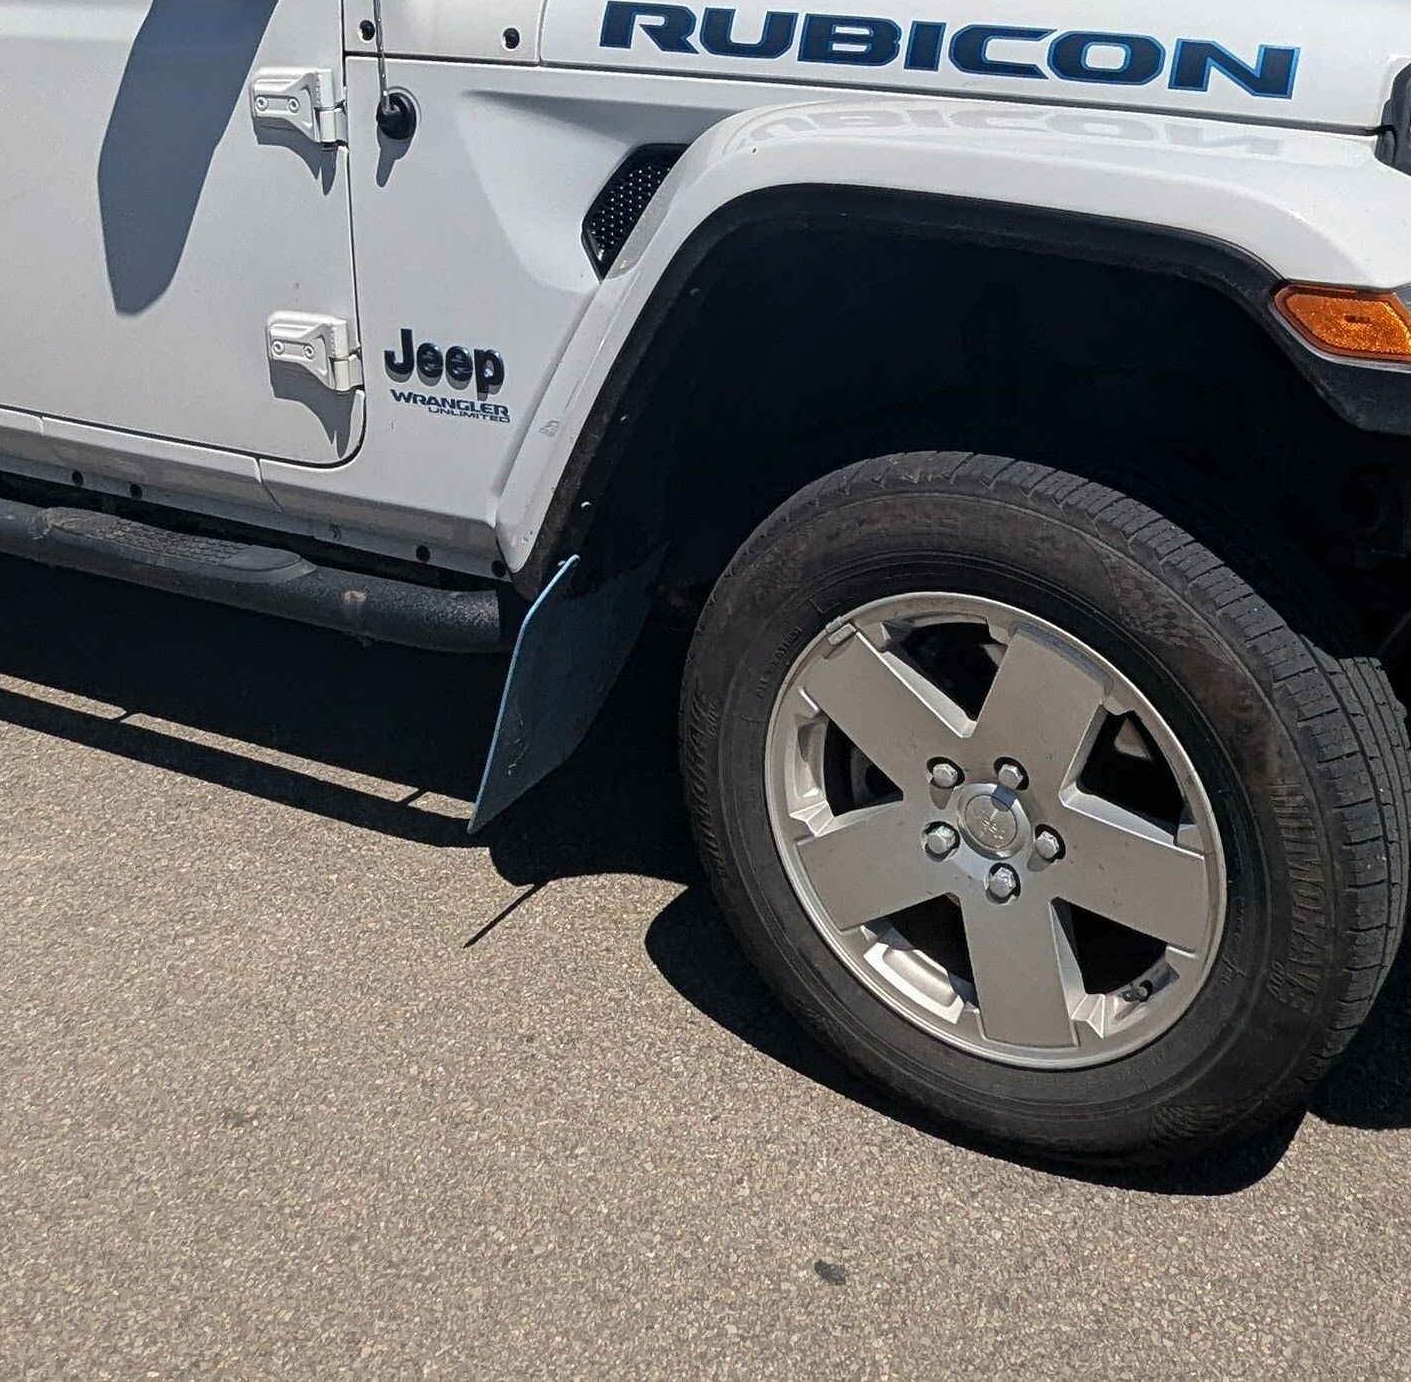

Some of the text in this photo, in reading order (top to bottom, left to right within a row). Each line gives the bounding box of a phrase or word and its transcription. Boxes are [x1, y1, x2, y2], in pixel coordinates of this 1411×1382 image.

[599, 0, 1301, 99] RUBICON
[384, 328, 505, 395] Jeep
[390, 389, 510, 417] WRANGLER
[428, 406, 511, 424] UNLIMITED
